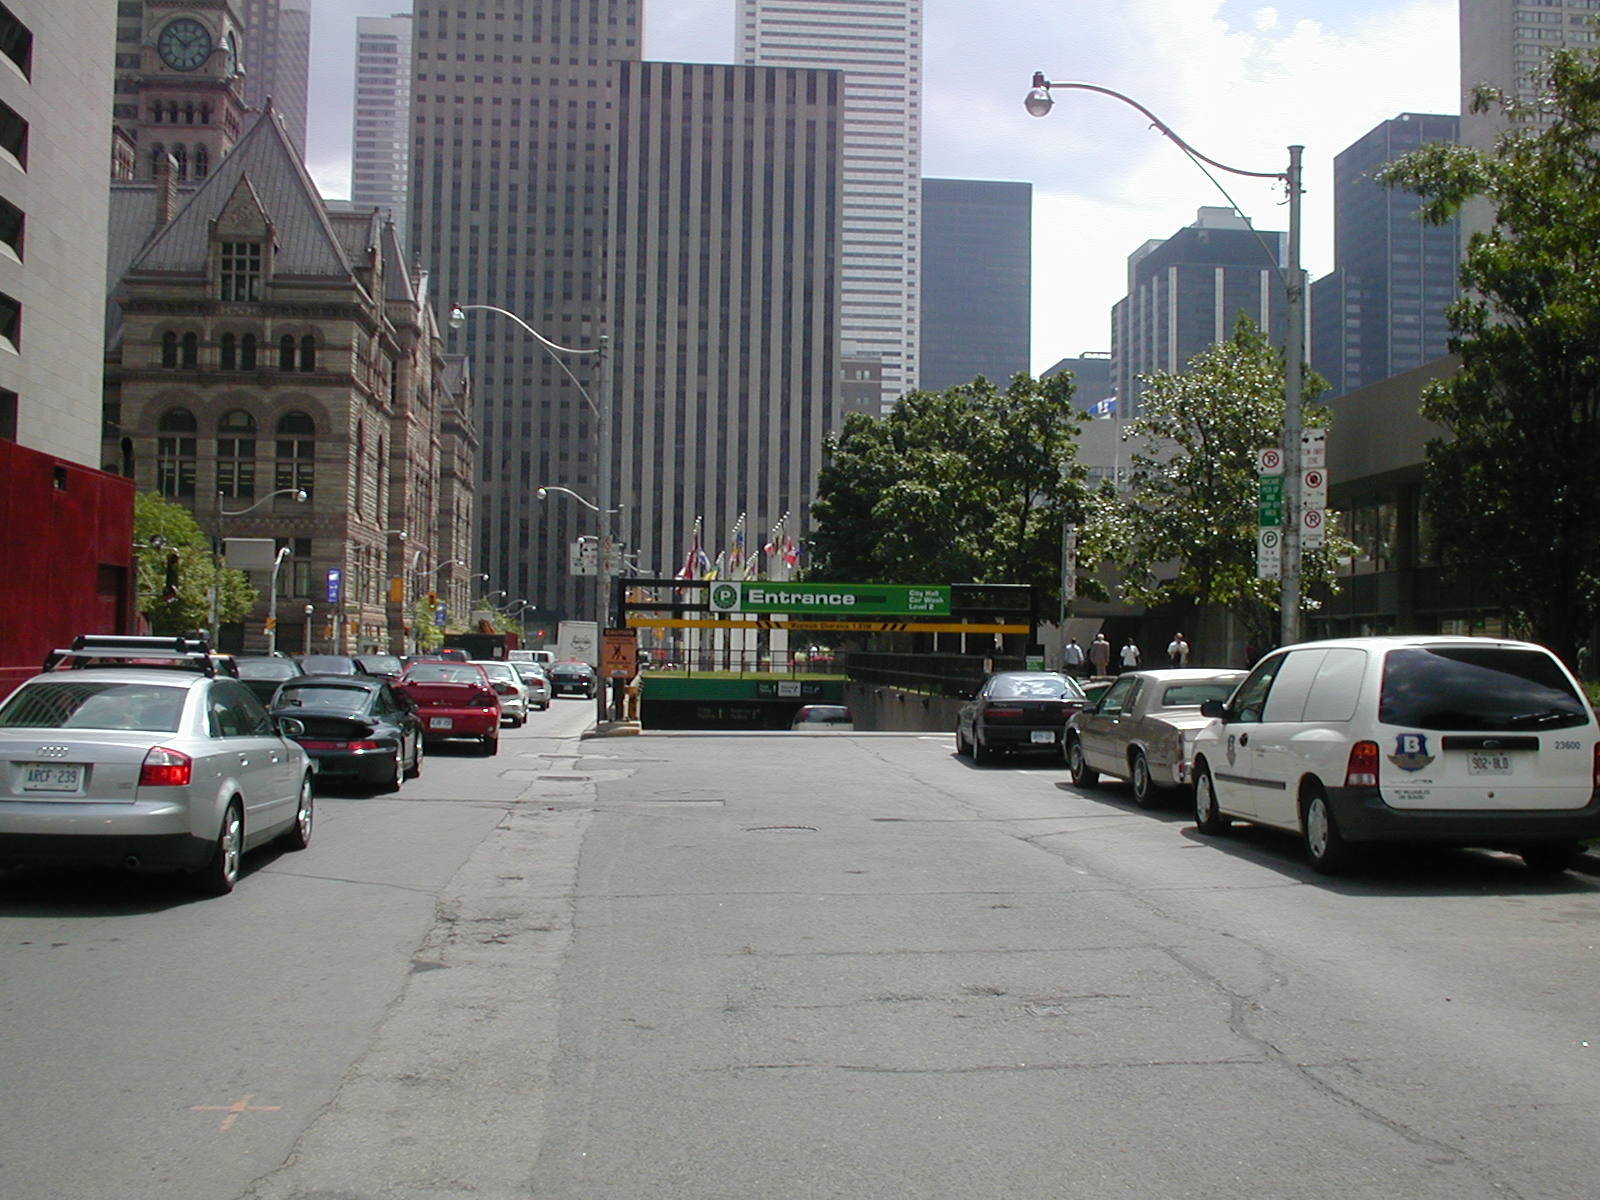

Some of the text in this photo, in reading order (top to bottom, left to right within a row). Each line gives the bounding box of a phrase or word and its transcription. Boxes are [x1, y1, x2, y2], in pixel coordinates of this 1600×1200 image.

[748, 589, 856, 606] Entrance
[1404, 736, 1419, 752] B
[1555, 740, 1581, 750] 23600
